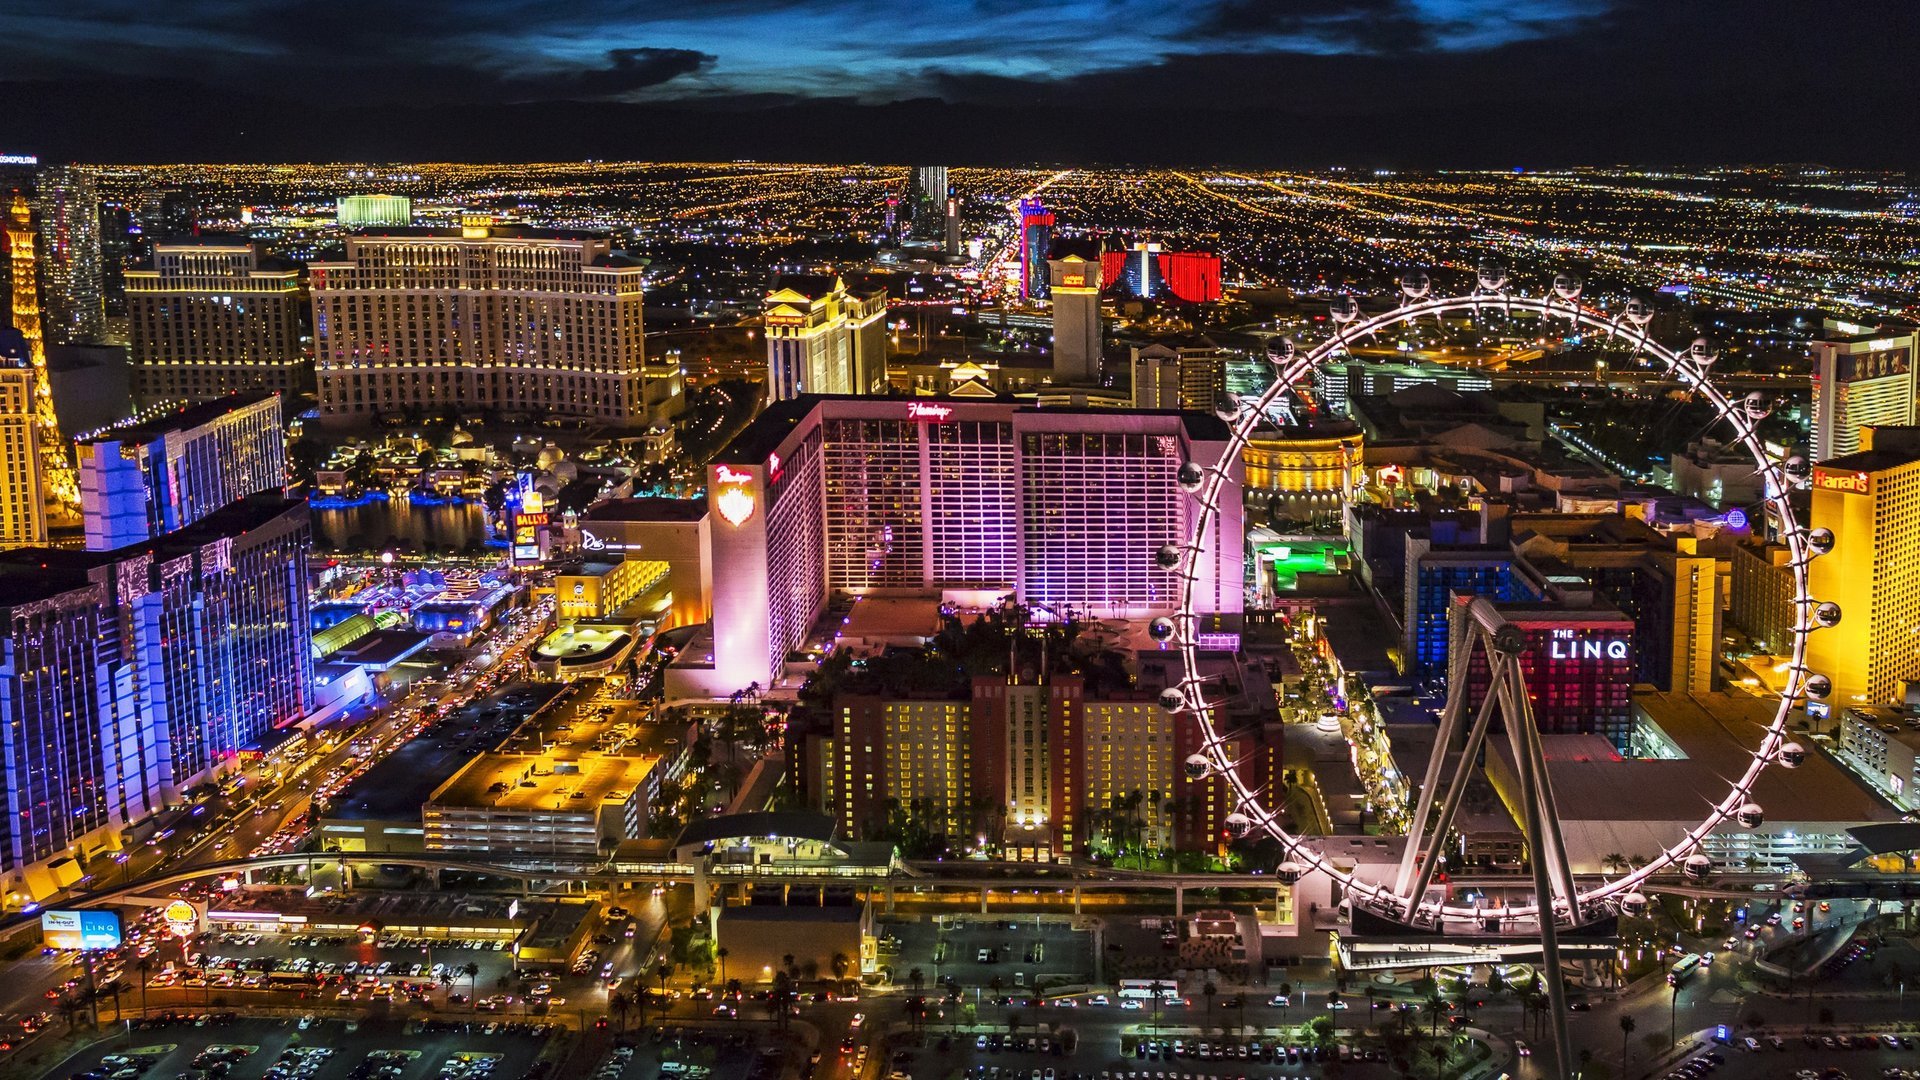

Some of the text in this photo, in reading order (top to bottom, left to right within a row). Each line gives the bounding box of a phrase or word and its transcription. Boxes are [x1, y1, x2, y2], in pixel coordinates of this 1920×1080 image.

[908, 402, 952, 420] Flamingo
[1553, 629, 1574, 639] THE
[1552, 640, 1627, 659] LINQ
